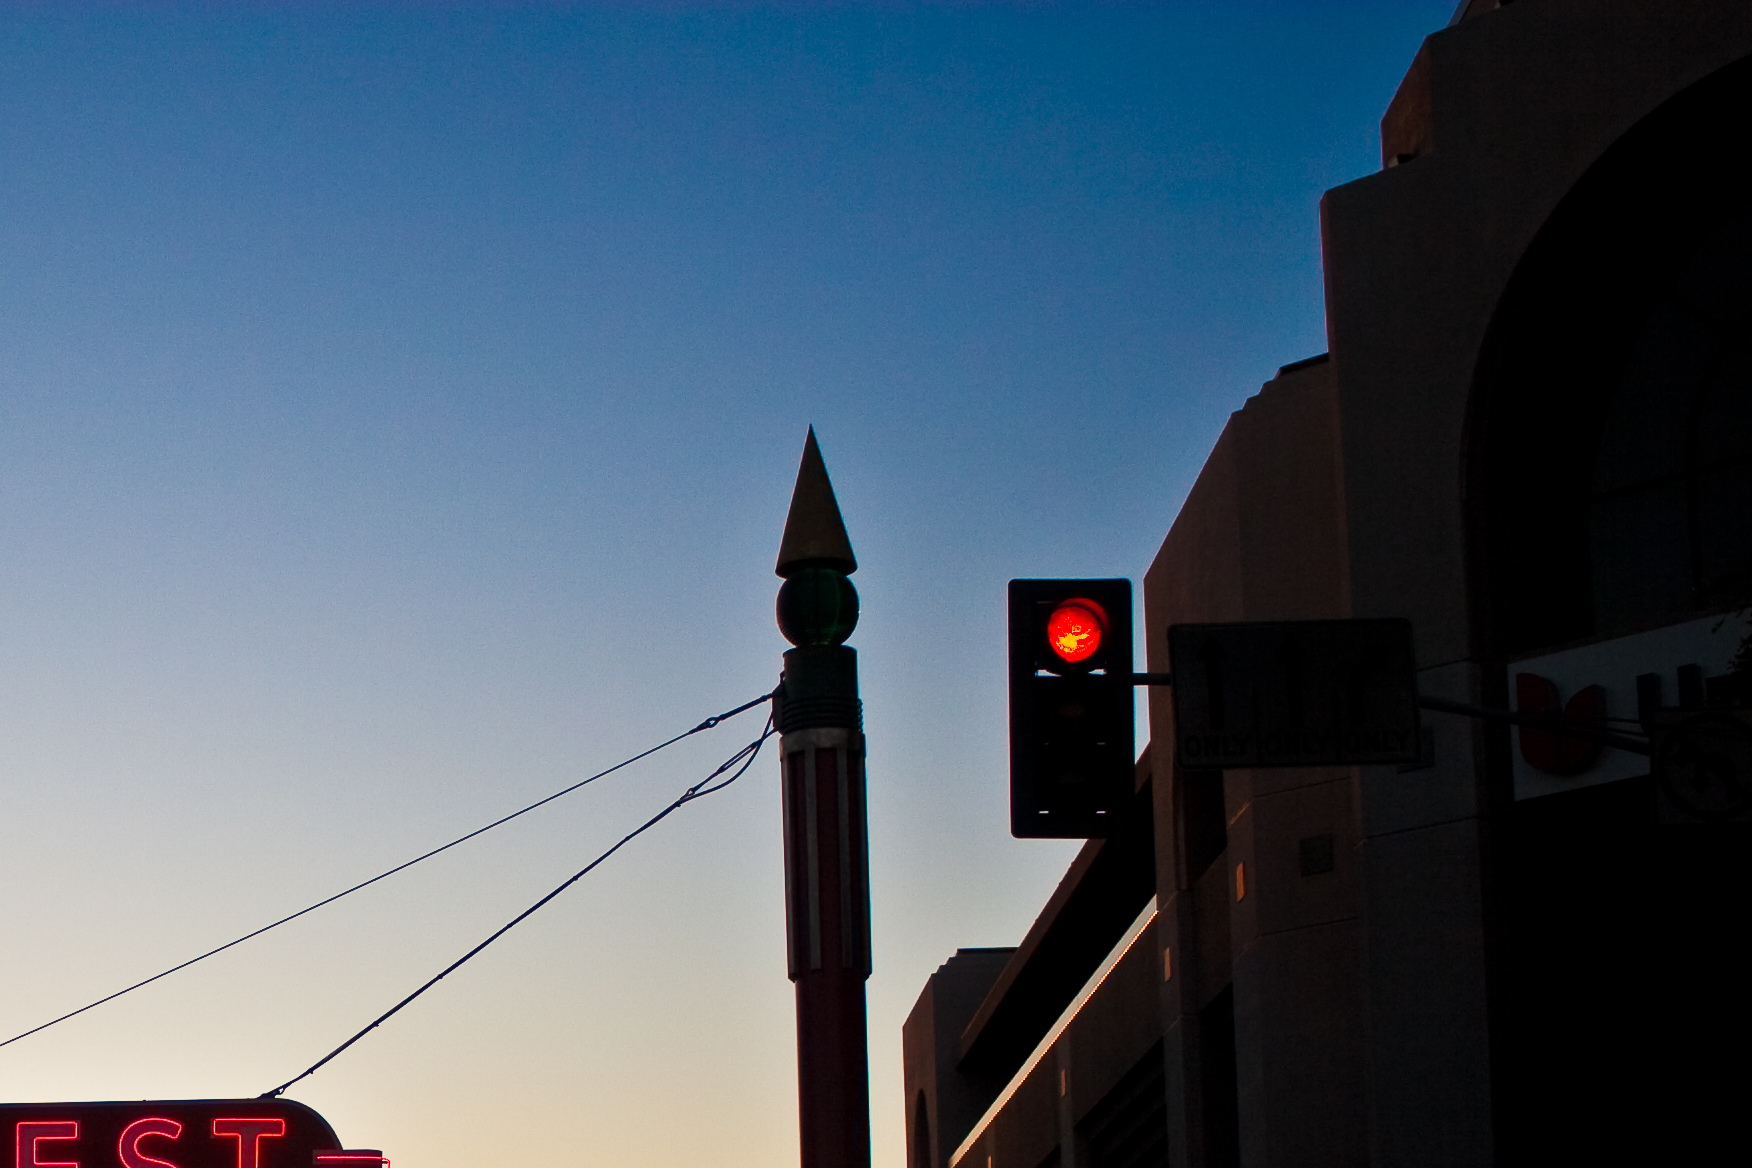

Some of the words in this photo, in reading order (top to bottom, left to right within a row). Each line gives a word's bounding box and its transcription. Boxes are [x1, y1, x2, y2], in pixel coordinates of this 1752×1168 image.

[1185, 734, 1250, 758] ONLY
[1264, 731, 1333, 756] ONLY
[1343, 729, 1412, 752] ONLY
